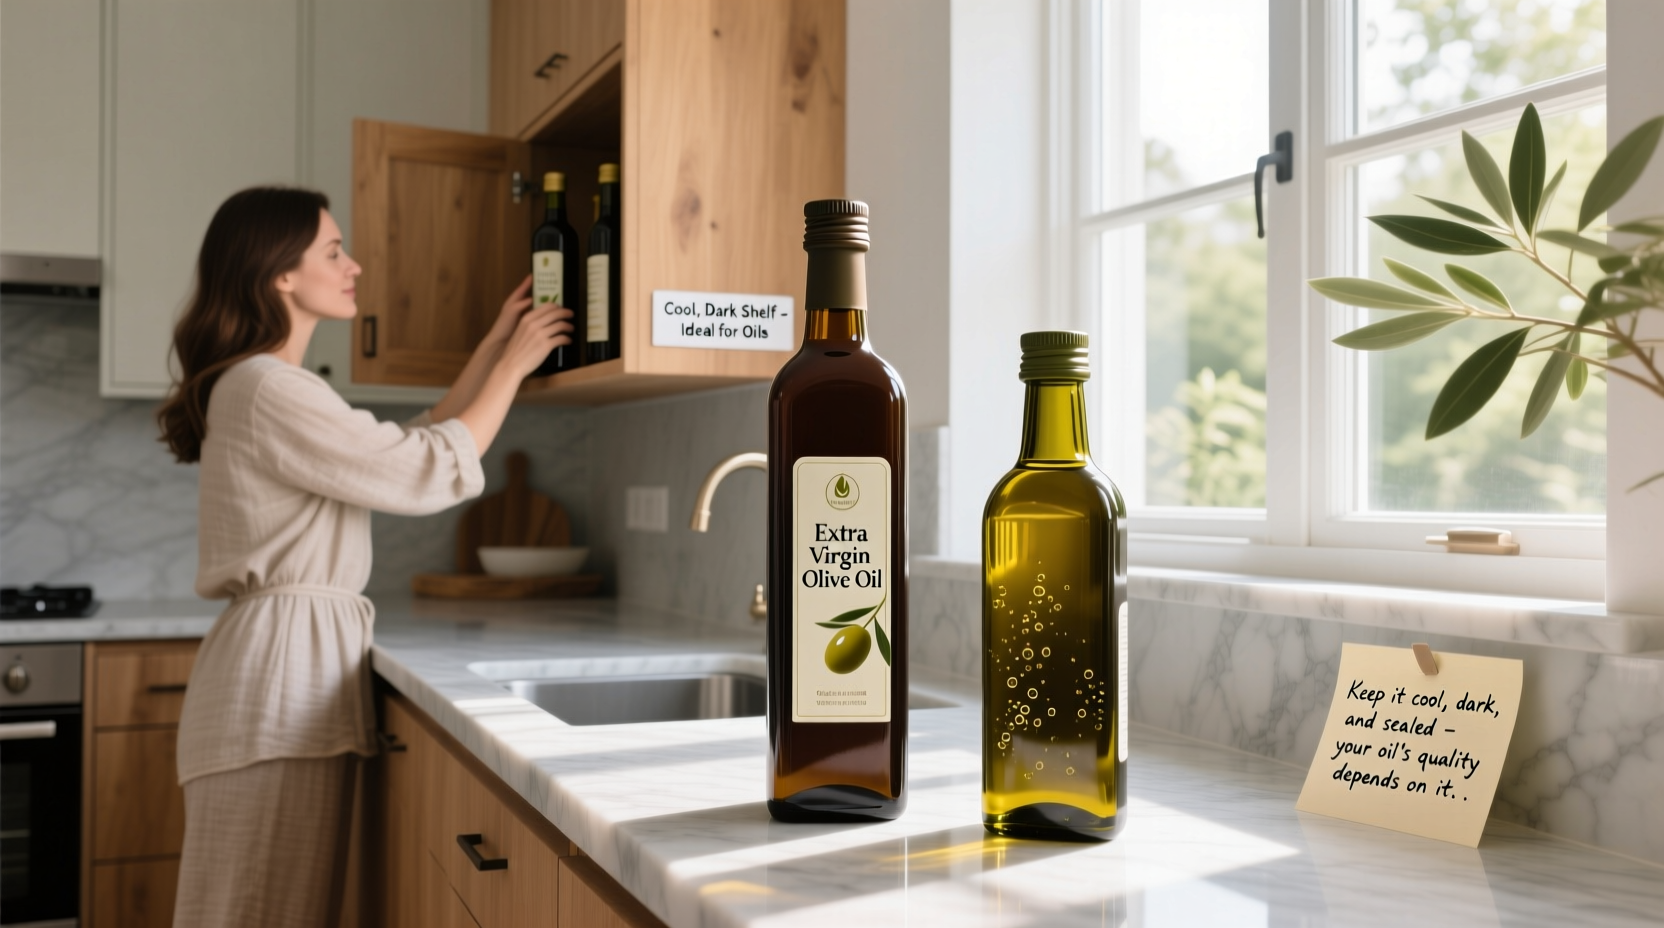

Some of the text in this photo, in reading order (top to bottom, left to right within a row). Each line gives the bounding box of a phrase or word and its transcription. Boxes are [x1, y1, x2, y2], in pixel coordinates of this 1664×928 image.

[664, 302, 701, 318] Cool,
[705, 303, 737, 318] Dark
[741, 304, 777, 319] Shelf
[681, 322, 769, 339] Ideal for Oils
[815, 523, 868, 542] Extra
[809, 546, 870, 570] Virgin
[802, 569, 882, 588] Olive Oil
[1347, 680, 1499, 718] Keep it cool, dark,
[1345, 711, 1377, 729] and
[1382, 716, 1437, 736] sealed
[1330, 741, 1480, 779] your oil's quality
[1332, 762, 1400, 790] depends
[1406, 781, 1427, 793] on
